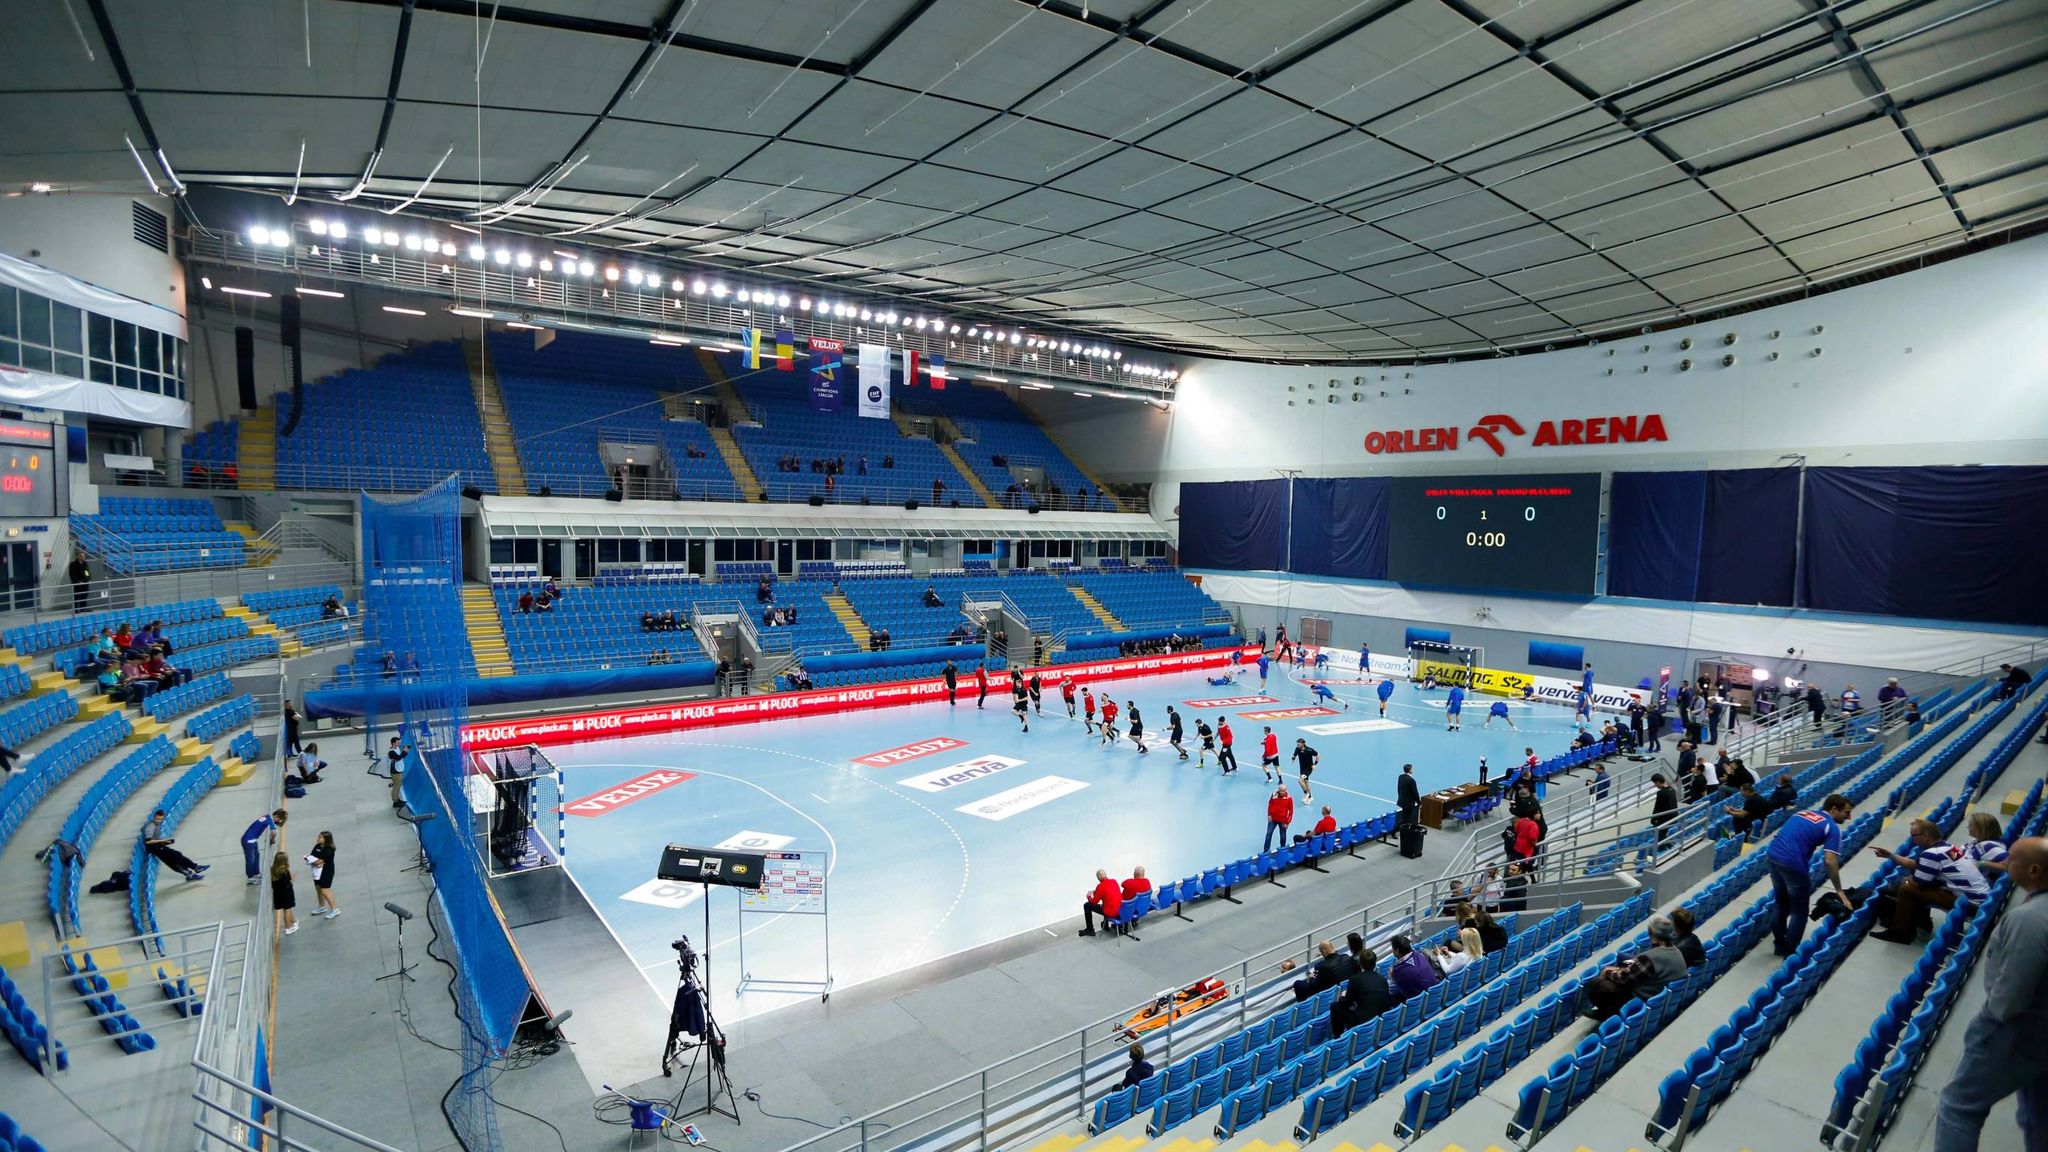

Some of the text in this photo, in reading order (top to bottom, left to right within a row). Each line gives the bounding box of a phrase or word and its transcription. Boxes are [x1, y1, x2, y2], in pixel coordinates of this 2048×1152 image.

[811, 339, 841, 350] VELUX
[1364, 414, 1668, 454] ORLEN ARENA
[1436, 506, 1536, 521] 0 1 0
[1466, 532, 1506, 547] 0:00
[520, 723, 568, 735] www.plock.eu
[625, 711, 668, 724] www.plock.eu
[718, 703, 756, 714] www.plock.eu
[864, 738, 953, 766] VELUX
[929, 761, 1009, 788] verva
[571, 773, 675, 811] VELUX
[1234, 984, 1240, 995] C
